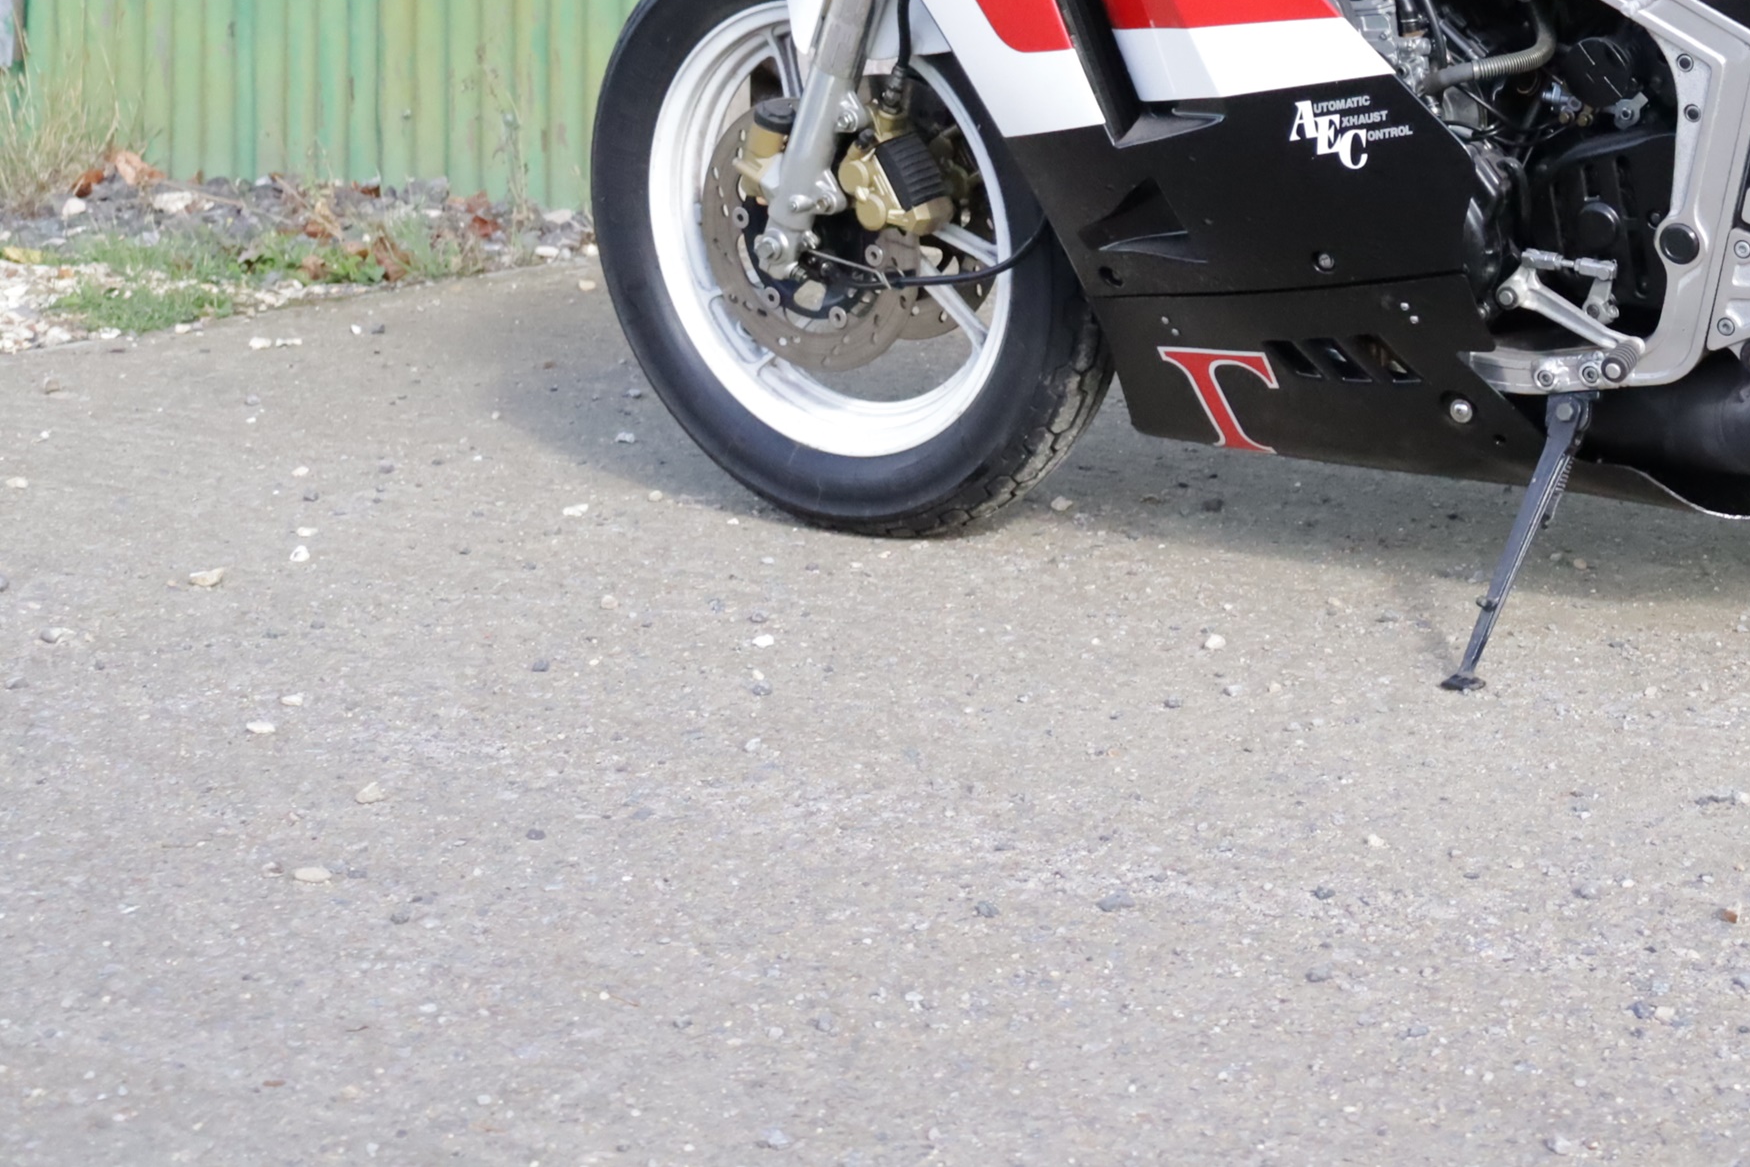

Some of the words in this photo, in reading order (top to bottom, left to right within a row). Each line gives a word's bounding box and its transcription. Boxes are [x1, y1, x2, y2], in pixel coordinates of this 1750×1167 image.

[1289, 95, 1371, 141] AUTOMATIC
[1314, 110, 1388, 155] EXHAUST
[1339, 125, 1413, 169] CONTROL
